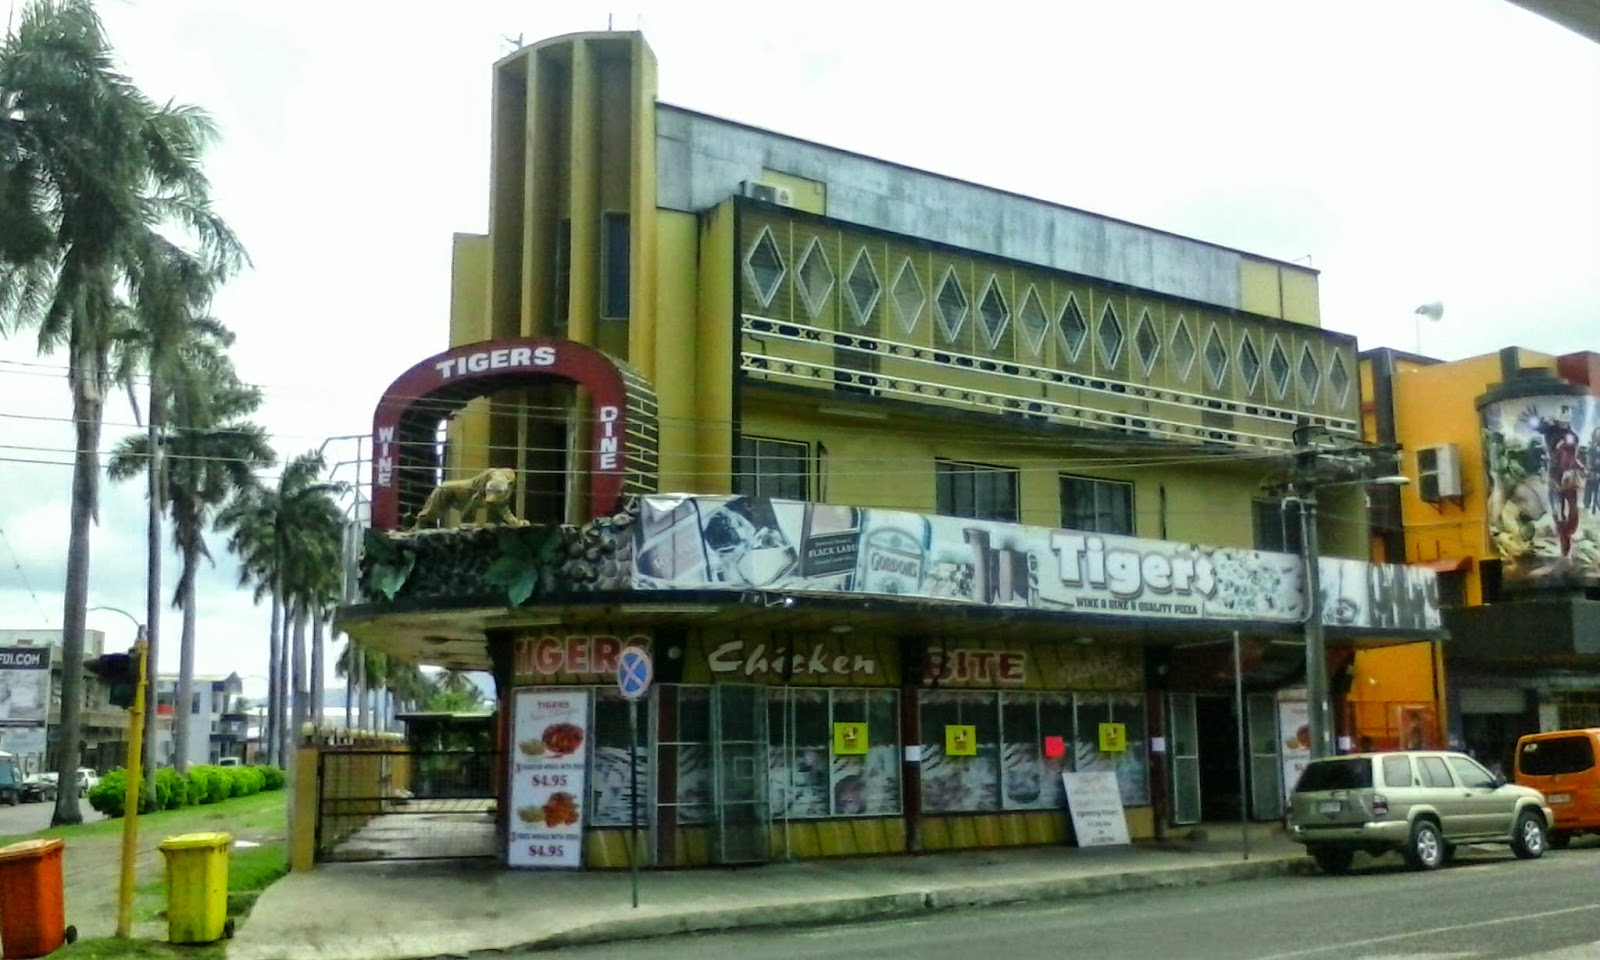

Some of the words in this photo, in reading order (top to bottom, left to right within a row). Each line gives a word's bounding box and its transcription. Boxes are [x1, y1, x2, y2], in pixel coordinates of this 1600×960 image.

[436, 346, 556, 378] TIGERS
[600, 406, 618, 470] DINE
[378, 426, 394, 487] WINE
[808, 546, 835, 558] BLACK
[1138, 601, 1172, 613] QUALITY
[708, 640, 875, 676] Chicken
[923, 647, 1027, 683] BITE
[532, 774, 567, 786] $4.95
[528, 845, 564, 857] $4.95
